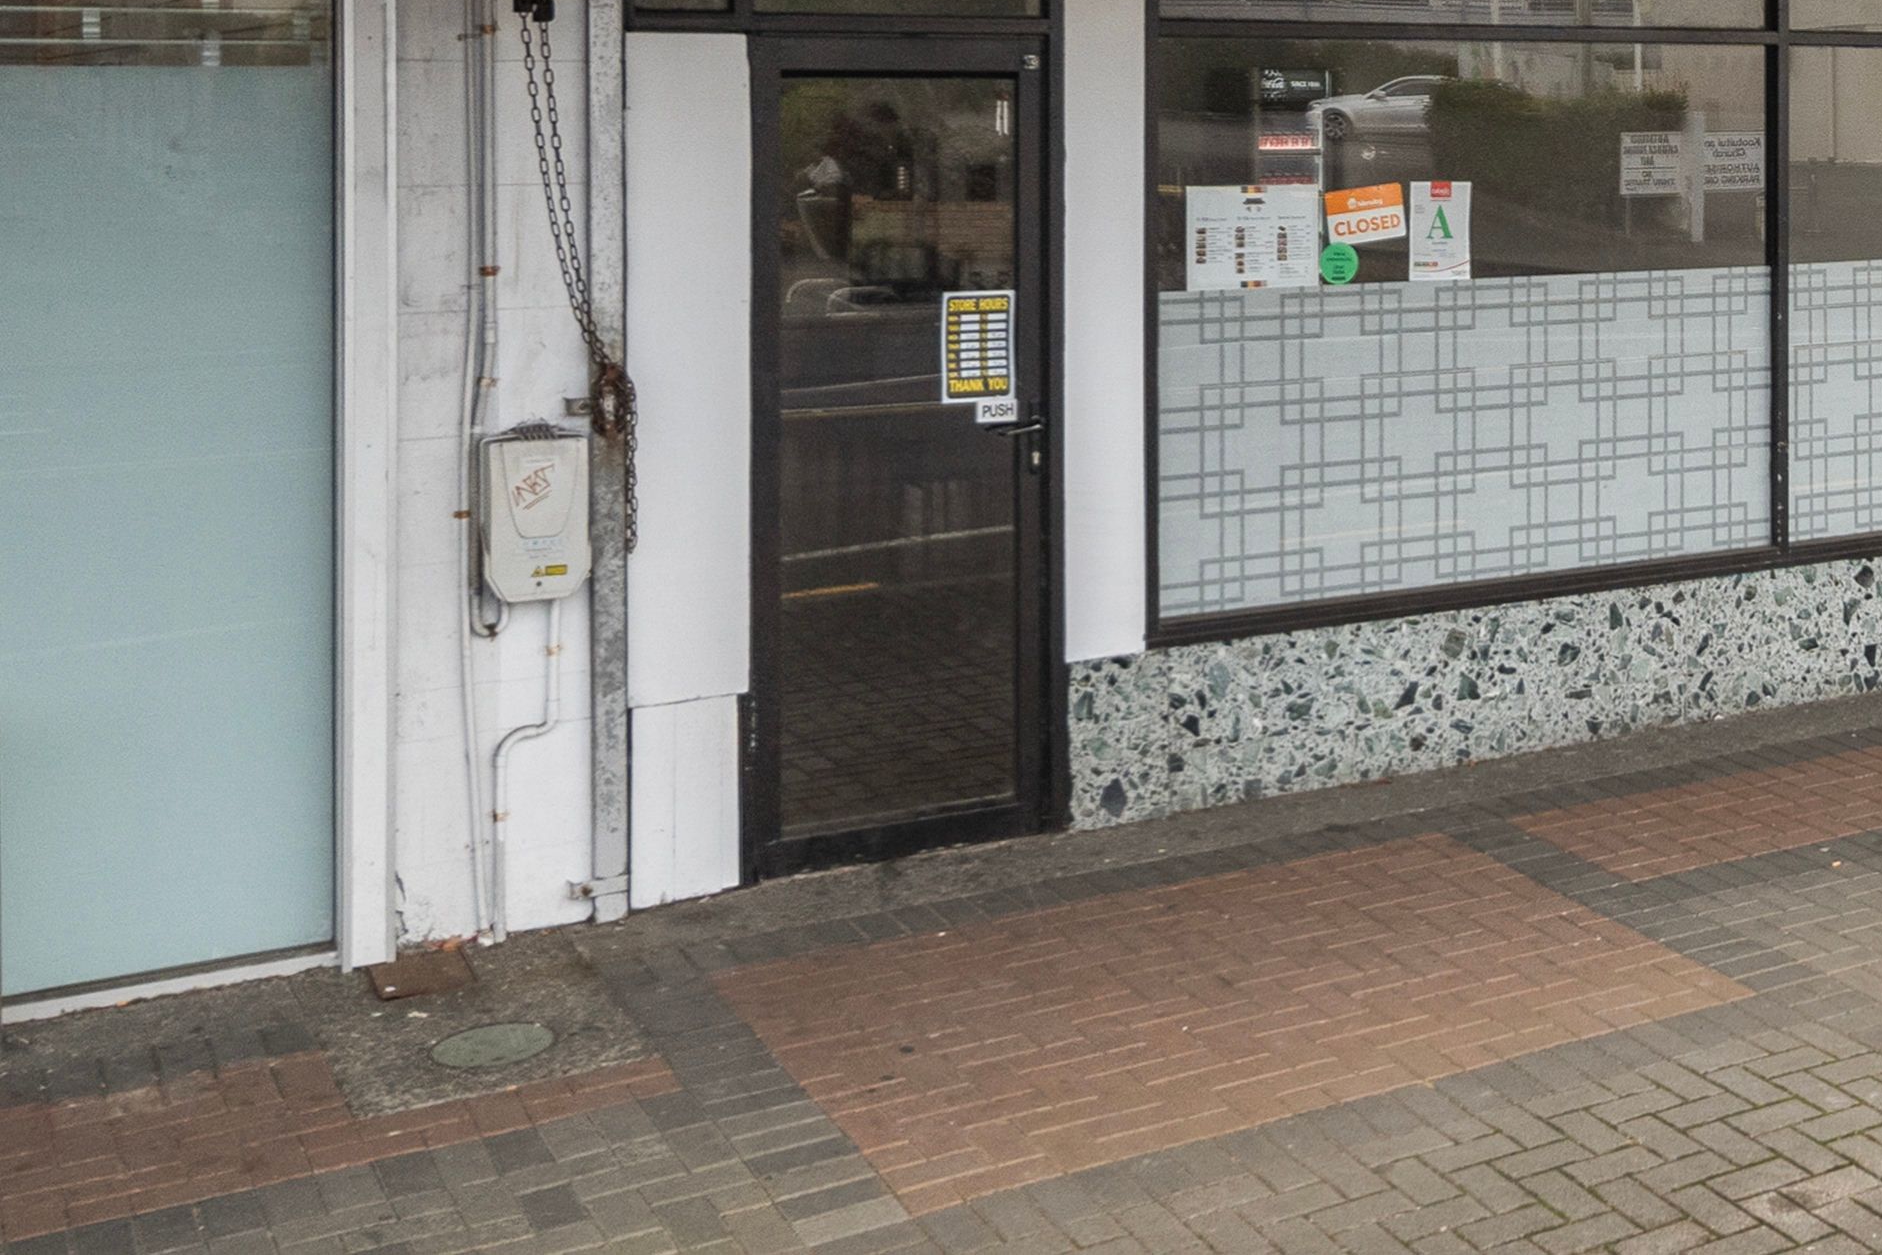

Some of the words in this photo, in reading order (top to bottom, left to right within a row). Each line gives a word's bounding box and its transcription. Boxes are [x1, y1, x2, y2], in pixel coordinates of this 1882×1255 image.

[1333, 213, 1401, 237] CLOSED
[1425, 204, 1454, 239] A
[949, 298, 976, 312] STORE
[978, 297, 1009, 311] HOURS
[949, 379, 985, 393] THANK
[987, 377, 1009, 391] YOU
[982, 403, 1015, 418] PUSH
